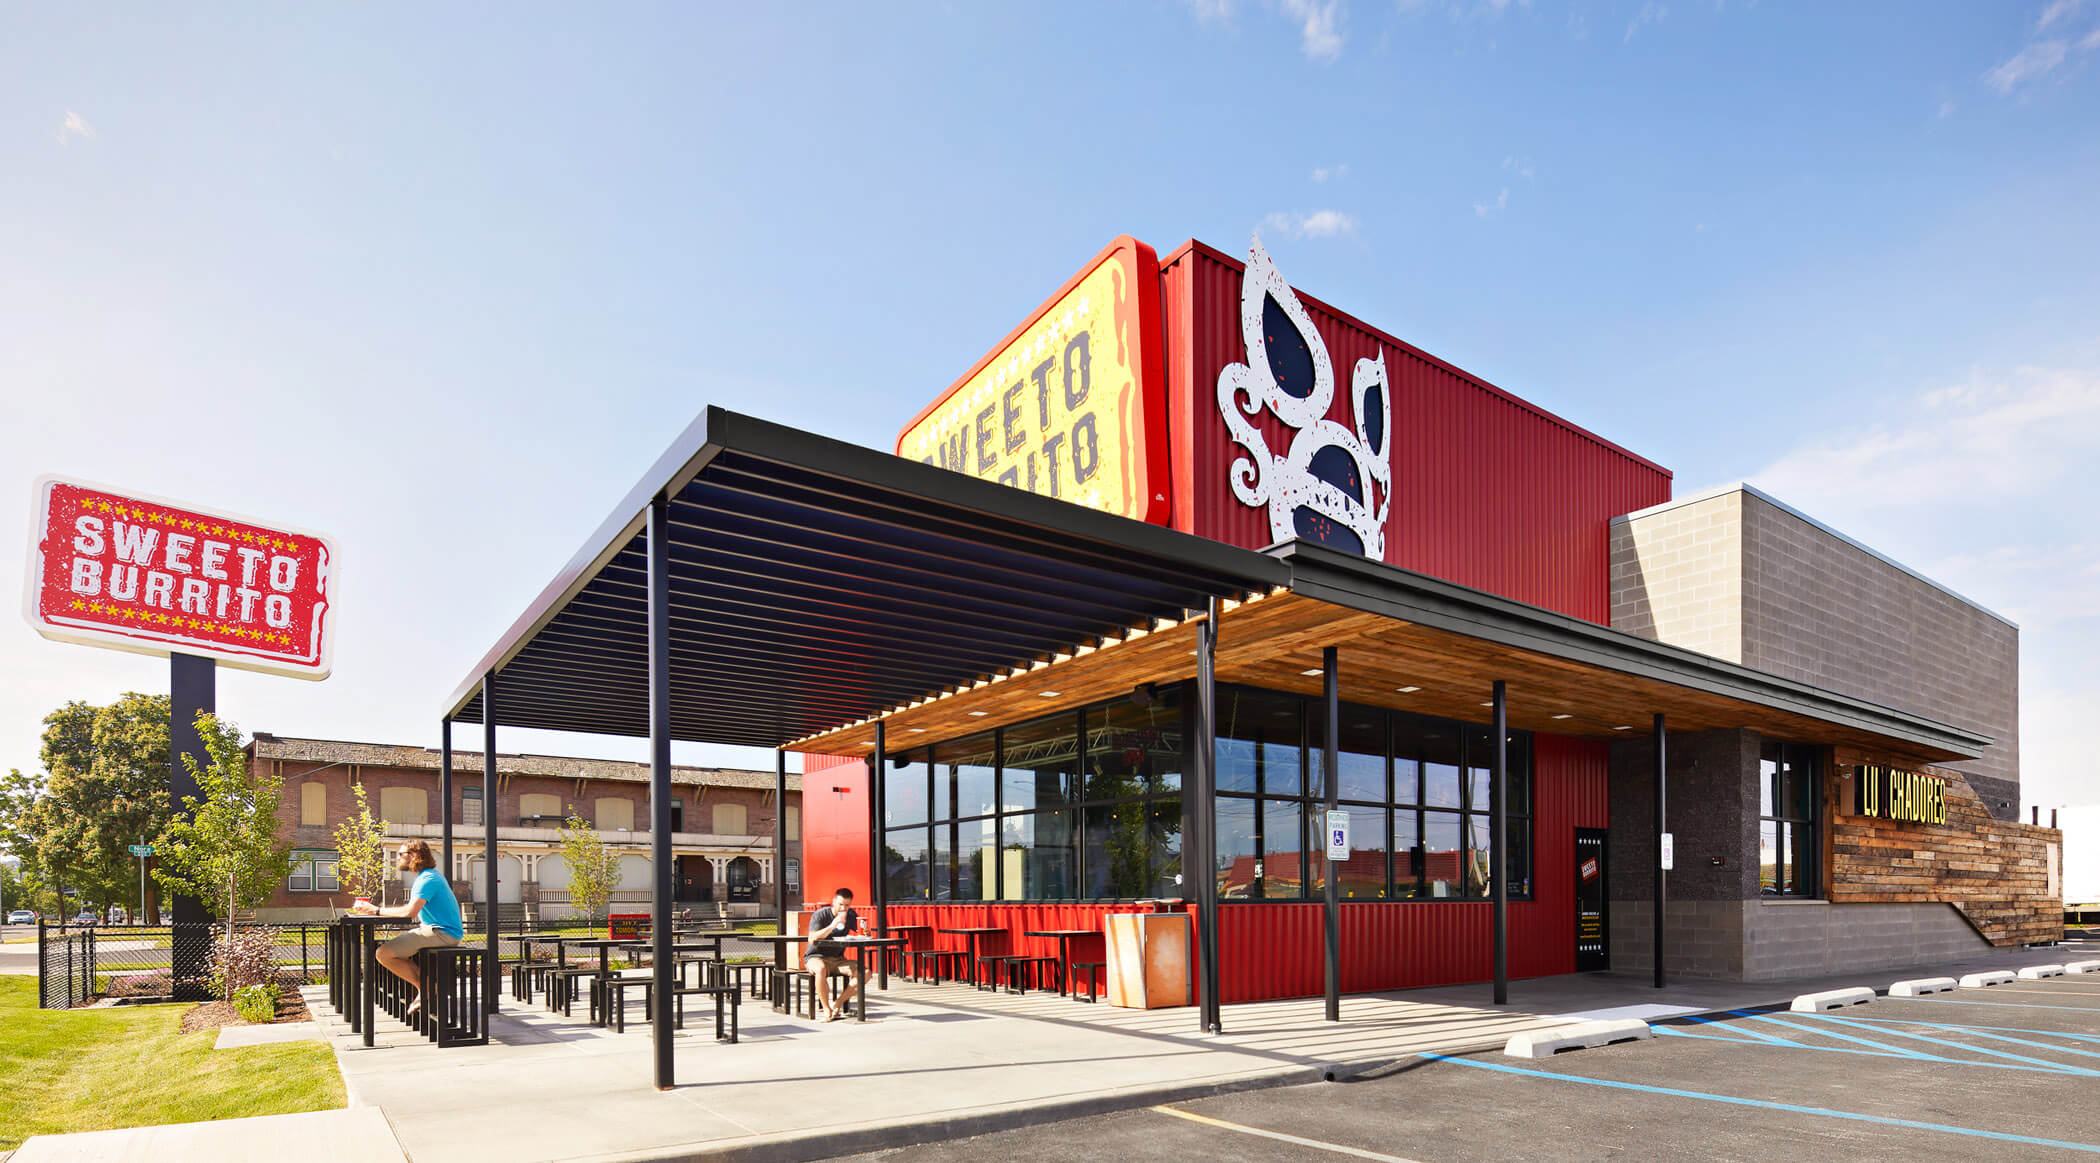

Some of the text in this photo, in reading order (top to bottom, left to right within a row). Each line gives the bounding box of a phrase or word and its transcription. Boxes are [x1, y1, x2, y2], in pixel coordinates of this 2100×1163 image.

[921, 330, 1092, 477] WEETO
[74, 515, 298, 592] SWEETO
[71, 556, 292, 629] BURRITO
